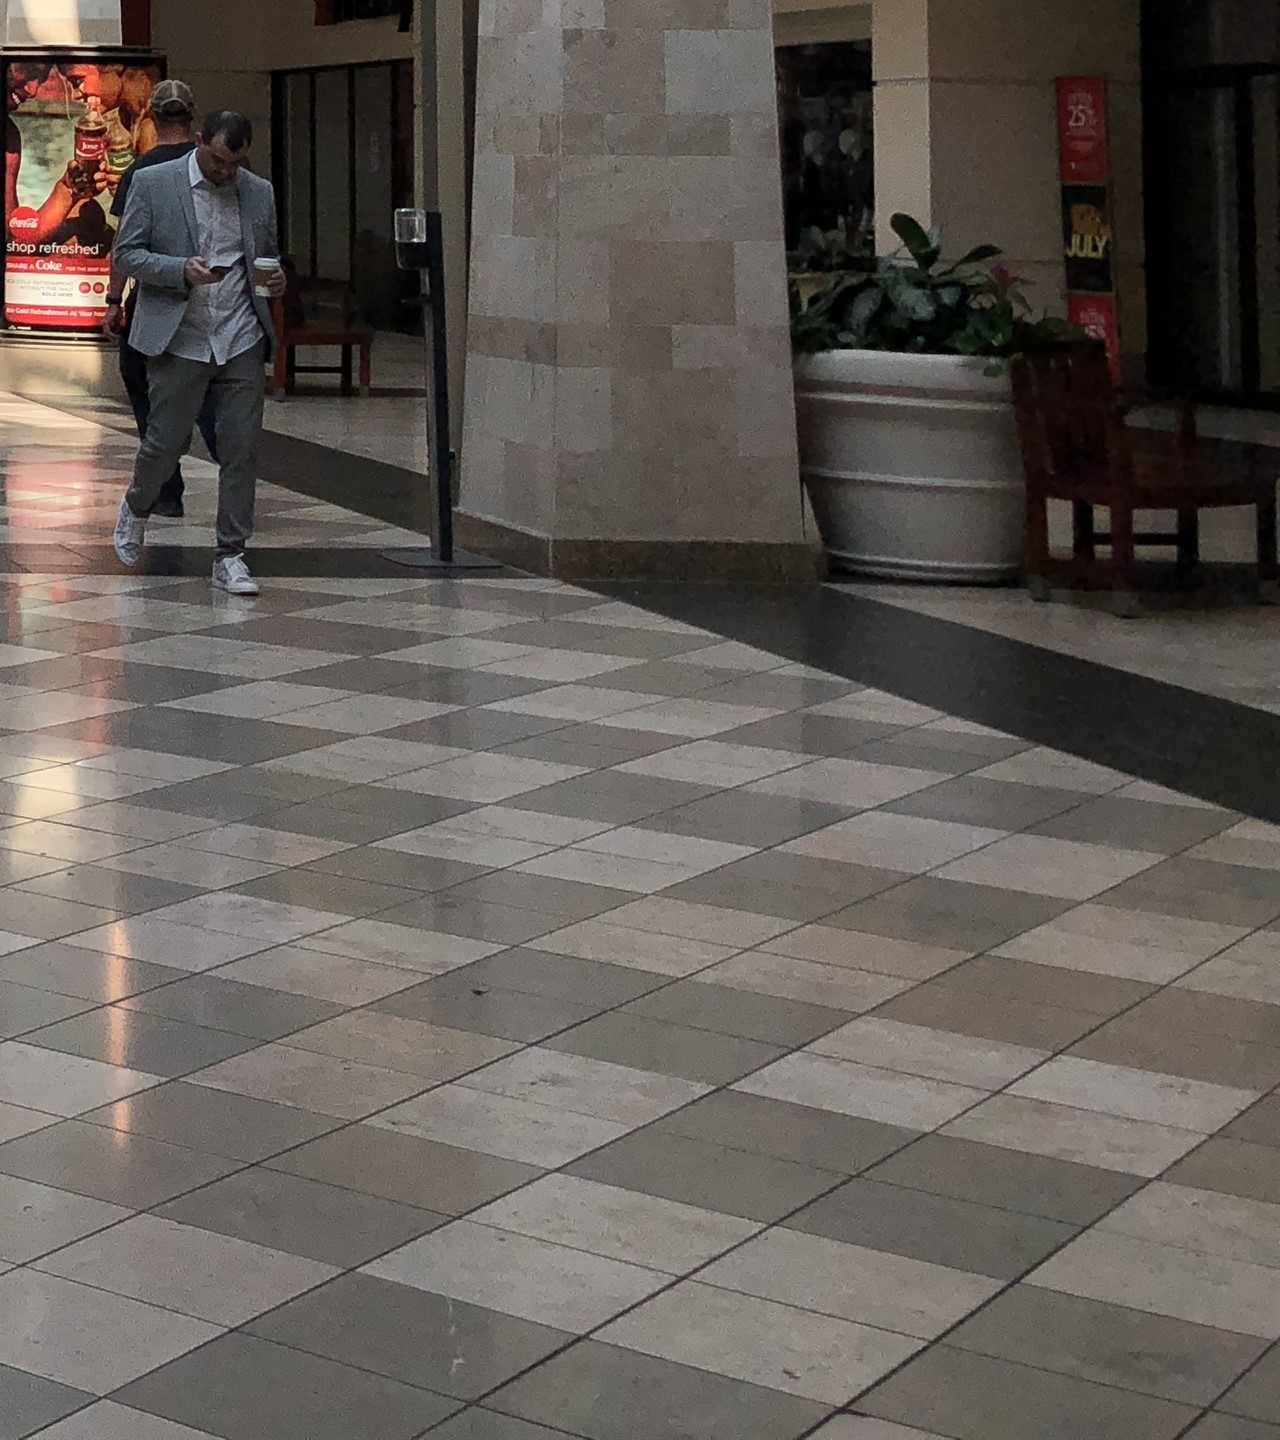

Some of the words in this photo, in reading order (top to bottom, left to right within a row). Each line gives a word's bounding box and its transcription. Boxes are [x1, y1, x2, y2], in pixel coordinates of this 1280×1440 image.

[6, 241, 36, 254] shop
[39, 242, 99, 255] refreshed
[35, 259, 63, 271] Coke
